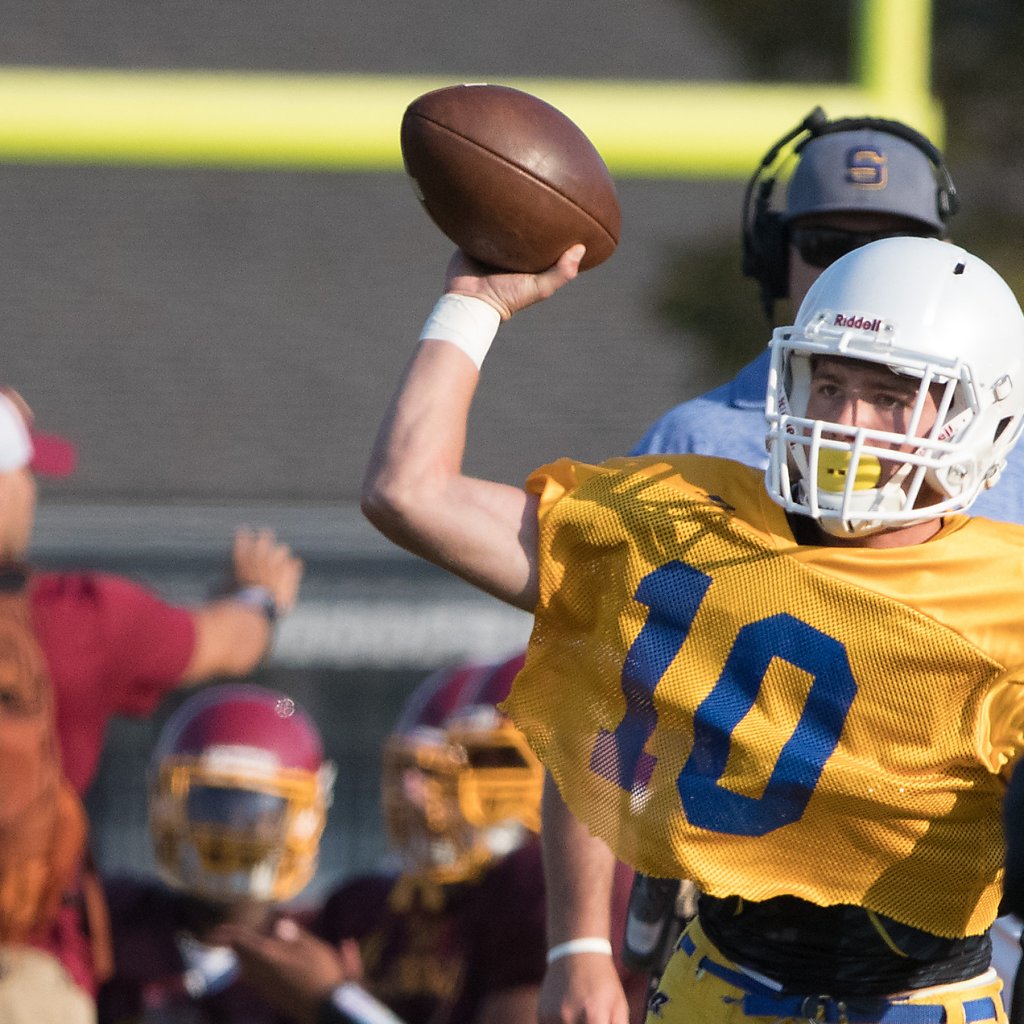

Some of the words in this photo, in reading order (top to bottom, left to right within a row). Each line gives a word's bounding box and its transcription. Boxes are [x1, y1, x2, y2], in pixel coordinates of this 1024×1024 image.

[846, 146, 888, 191] S
[834, 314, 881, 332] Riddell
[589, 560, 858, 837] 10
